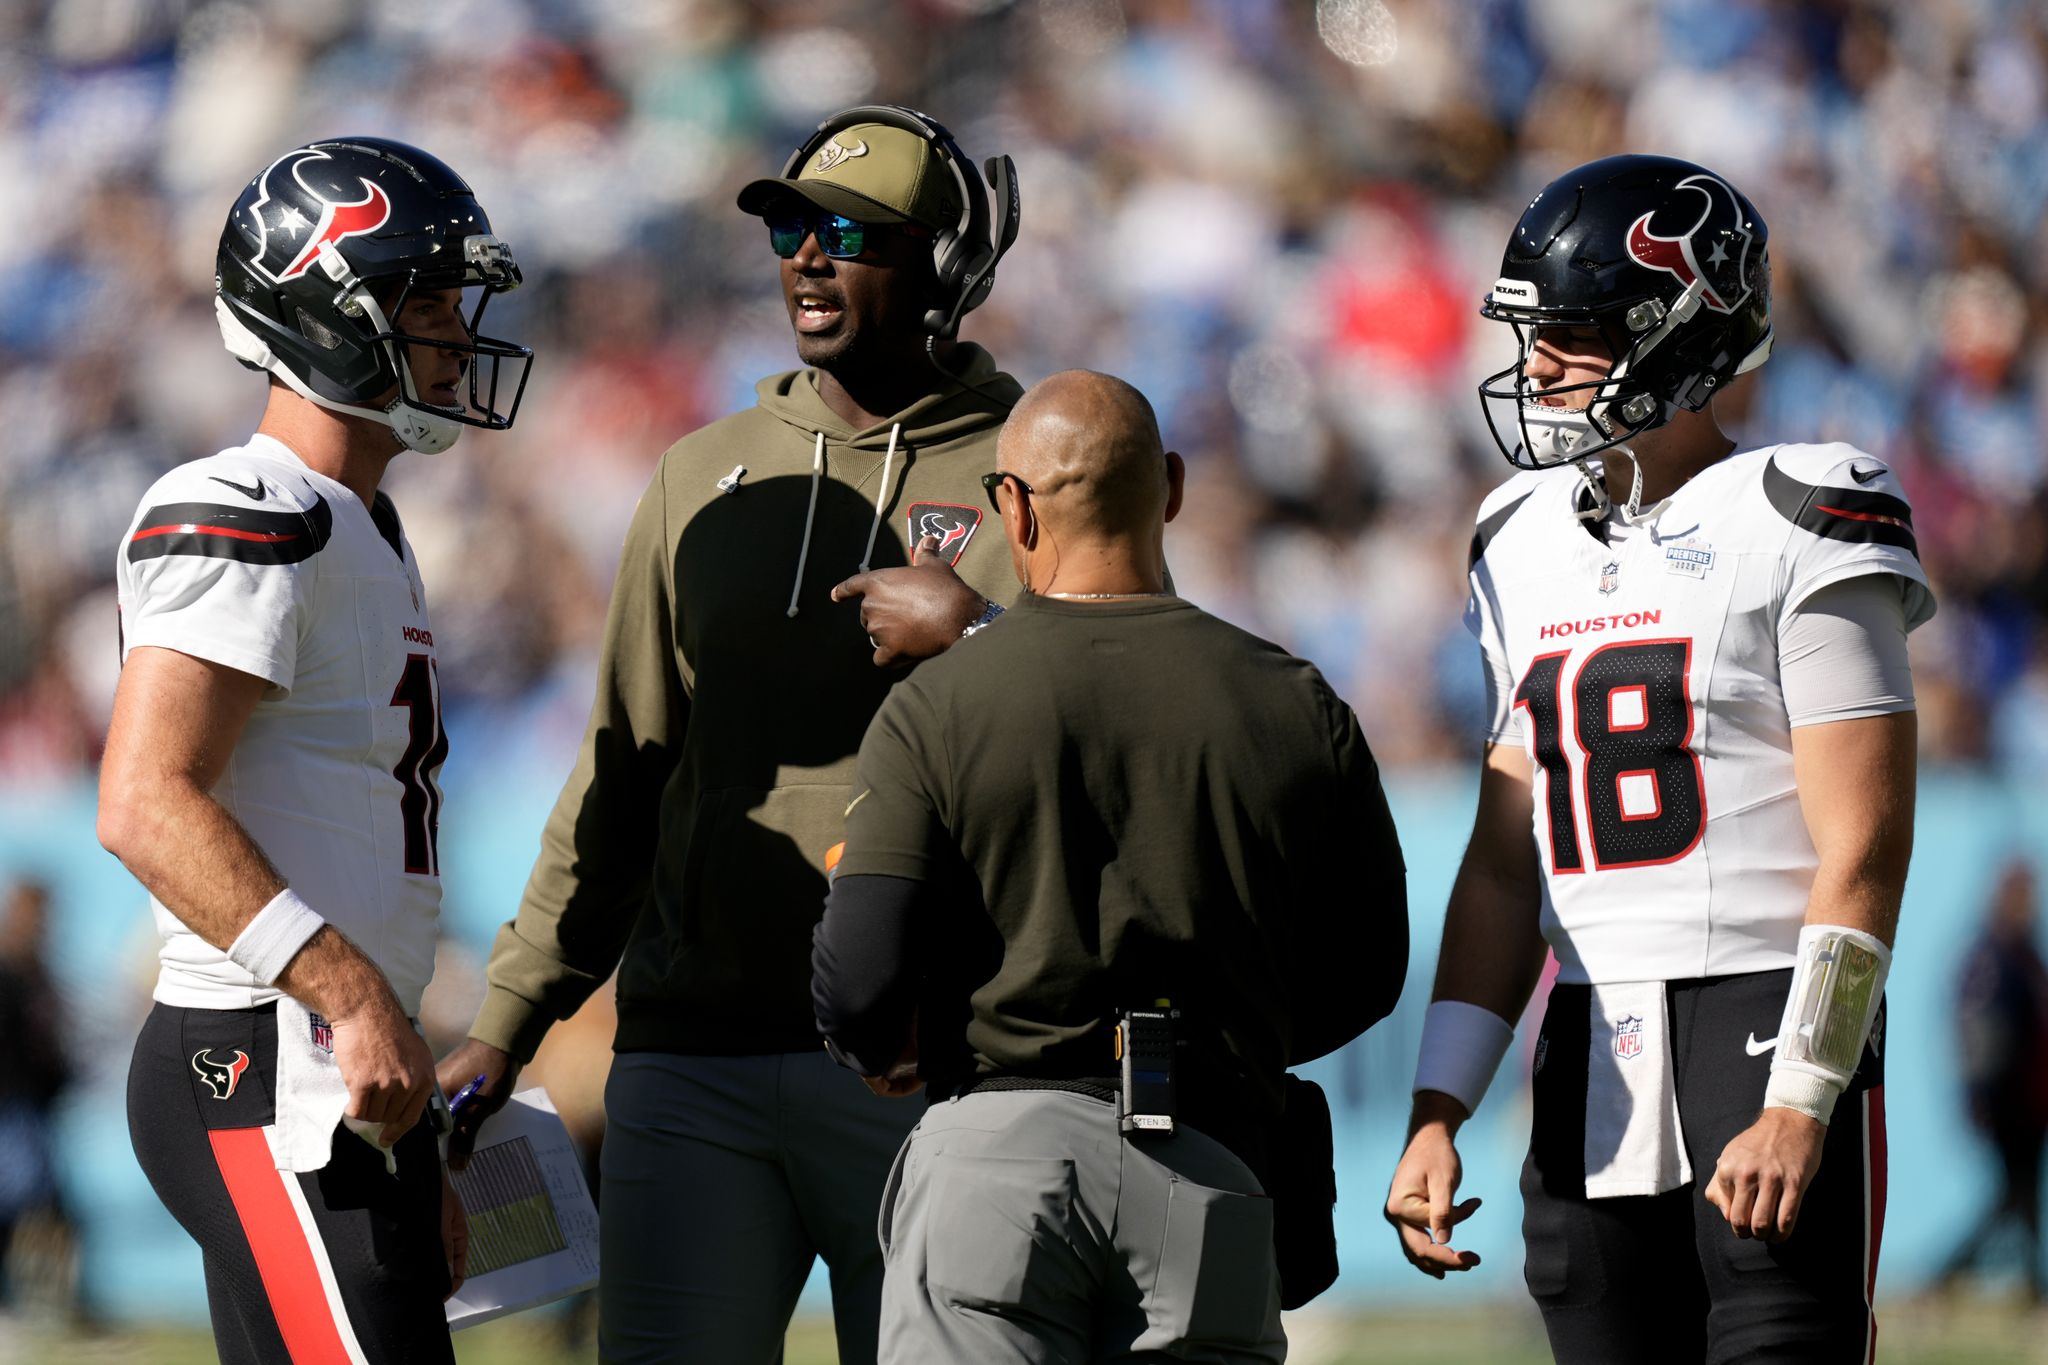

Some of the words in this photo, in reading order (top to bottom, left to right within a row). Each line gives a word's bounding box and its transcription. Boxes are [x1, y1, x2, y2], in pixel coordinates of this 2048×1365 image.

[1010, 172, 1019, 223] SONY
[1667, 548, 1711, 565] PREMIERE
[1540, 609, 1662, 640] HOUSTON
[1512, 637, 1708, 875] 18
[314, 1027, 333, 1049] NF
[1618, 1034, 1640, 1054] NFL
